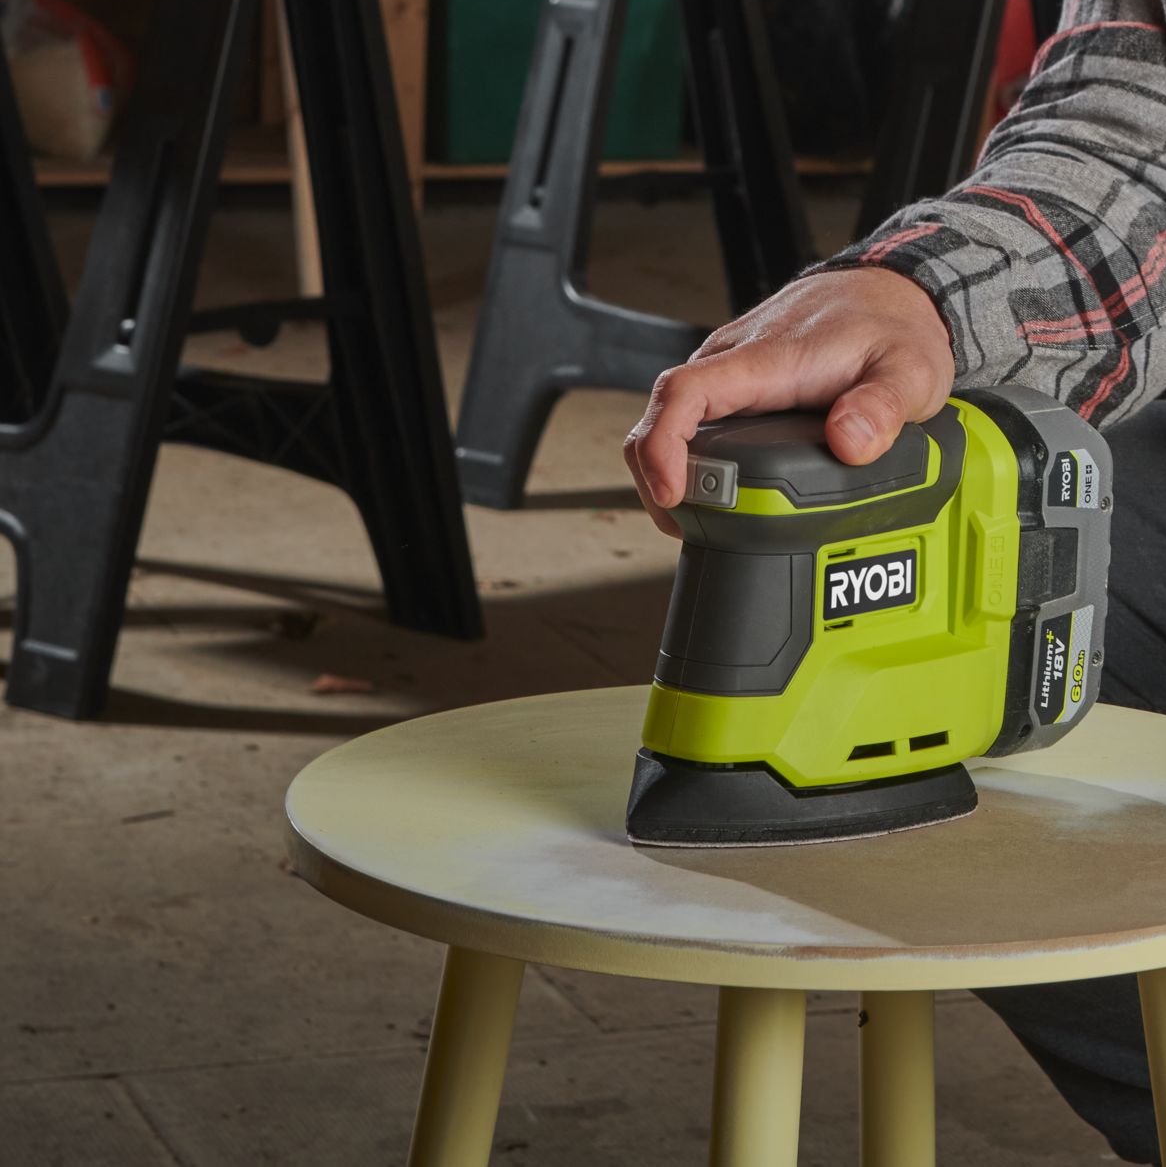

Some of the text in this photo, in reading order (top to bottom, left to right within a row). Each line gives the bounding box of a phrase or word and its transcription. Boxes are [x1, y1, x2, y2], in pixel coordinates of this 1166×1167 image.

[1061, 458, 1071, 502] RYOBI
[829, 558, 912, 609] RYOBI
[1053, 637, 1066, 681] 18V
